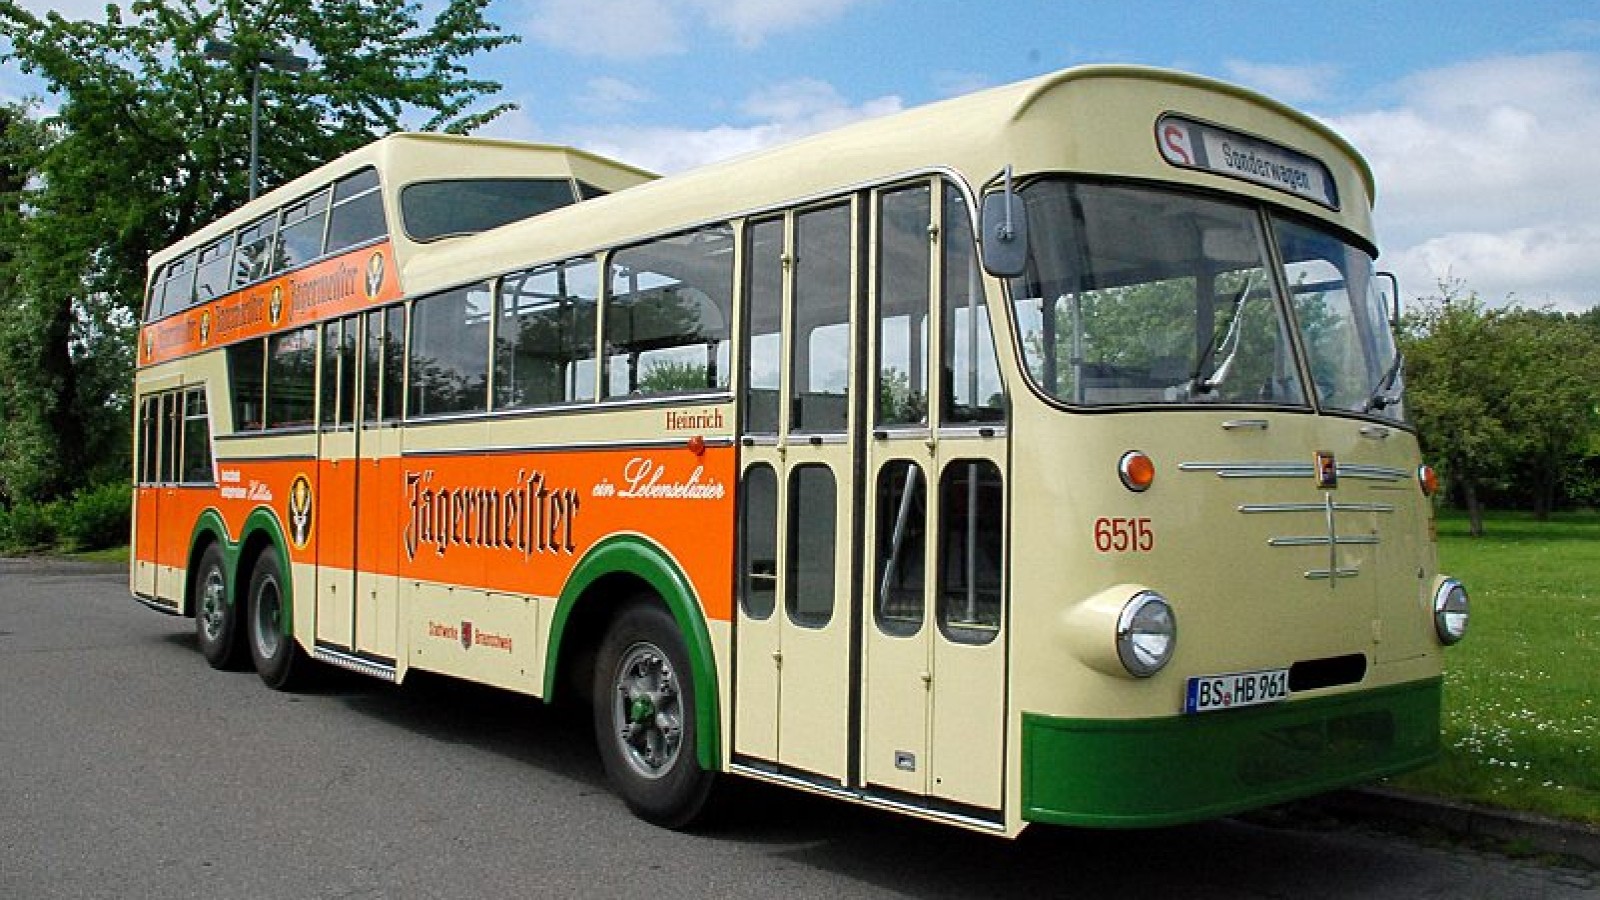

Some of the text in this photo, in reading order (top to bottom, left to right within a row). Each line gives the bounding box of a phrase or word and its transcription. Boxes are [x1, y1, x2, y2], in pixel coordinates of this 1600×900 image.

[1222, 141, 1312, 191] Sonderwagen
[666, 408, 723, 430] Heinrich
[592, 477, 616, 497] ein
[1094, 517, 1154, 552] 6515
[1200, 672, 1286, 707] BS HB 961
